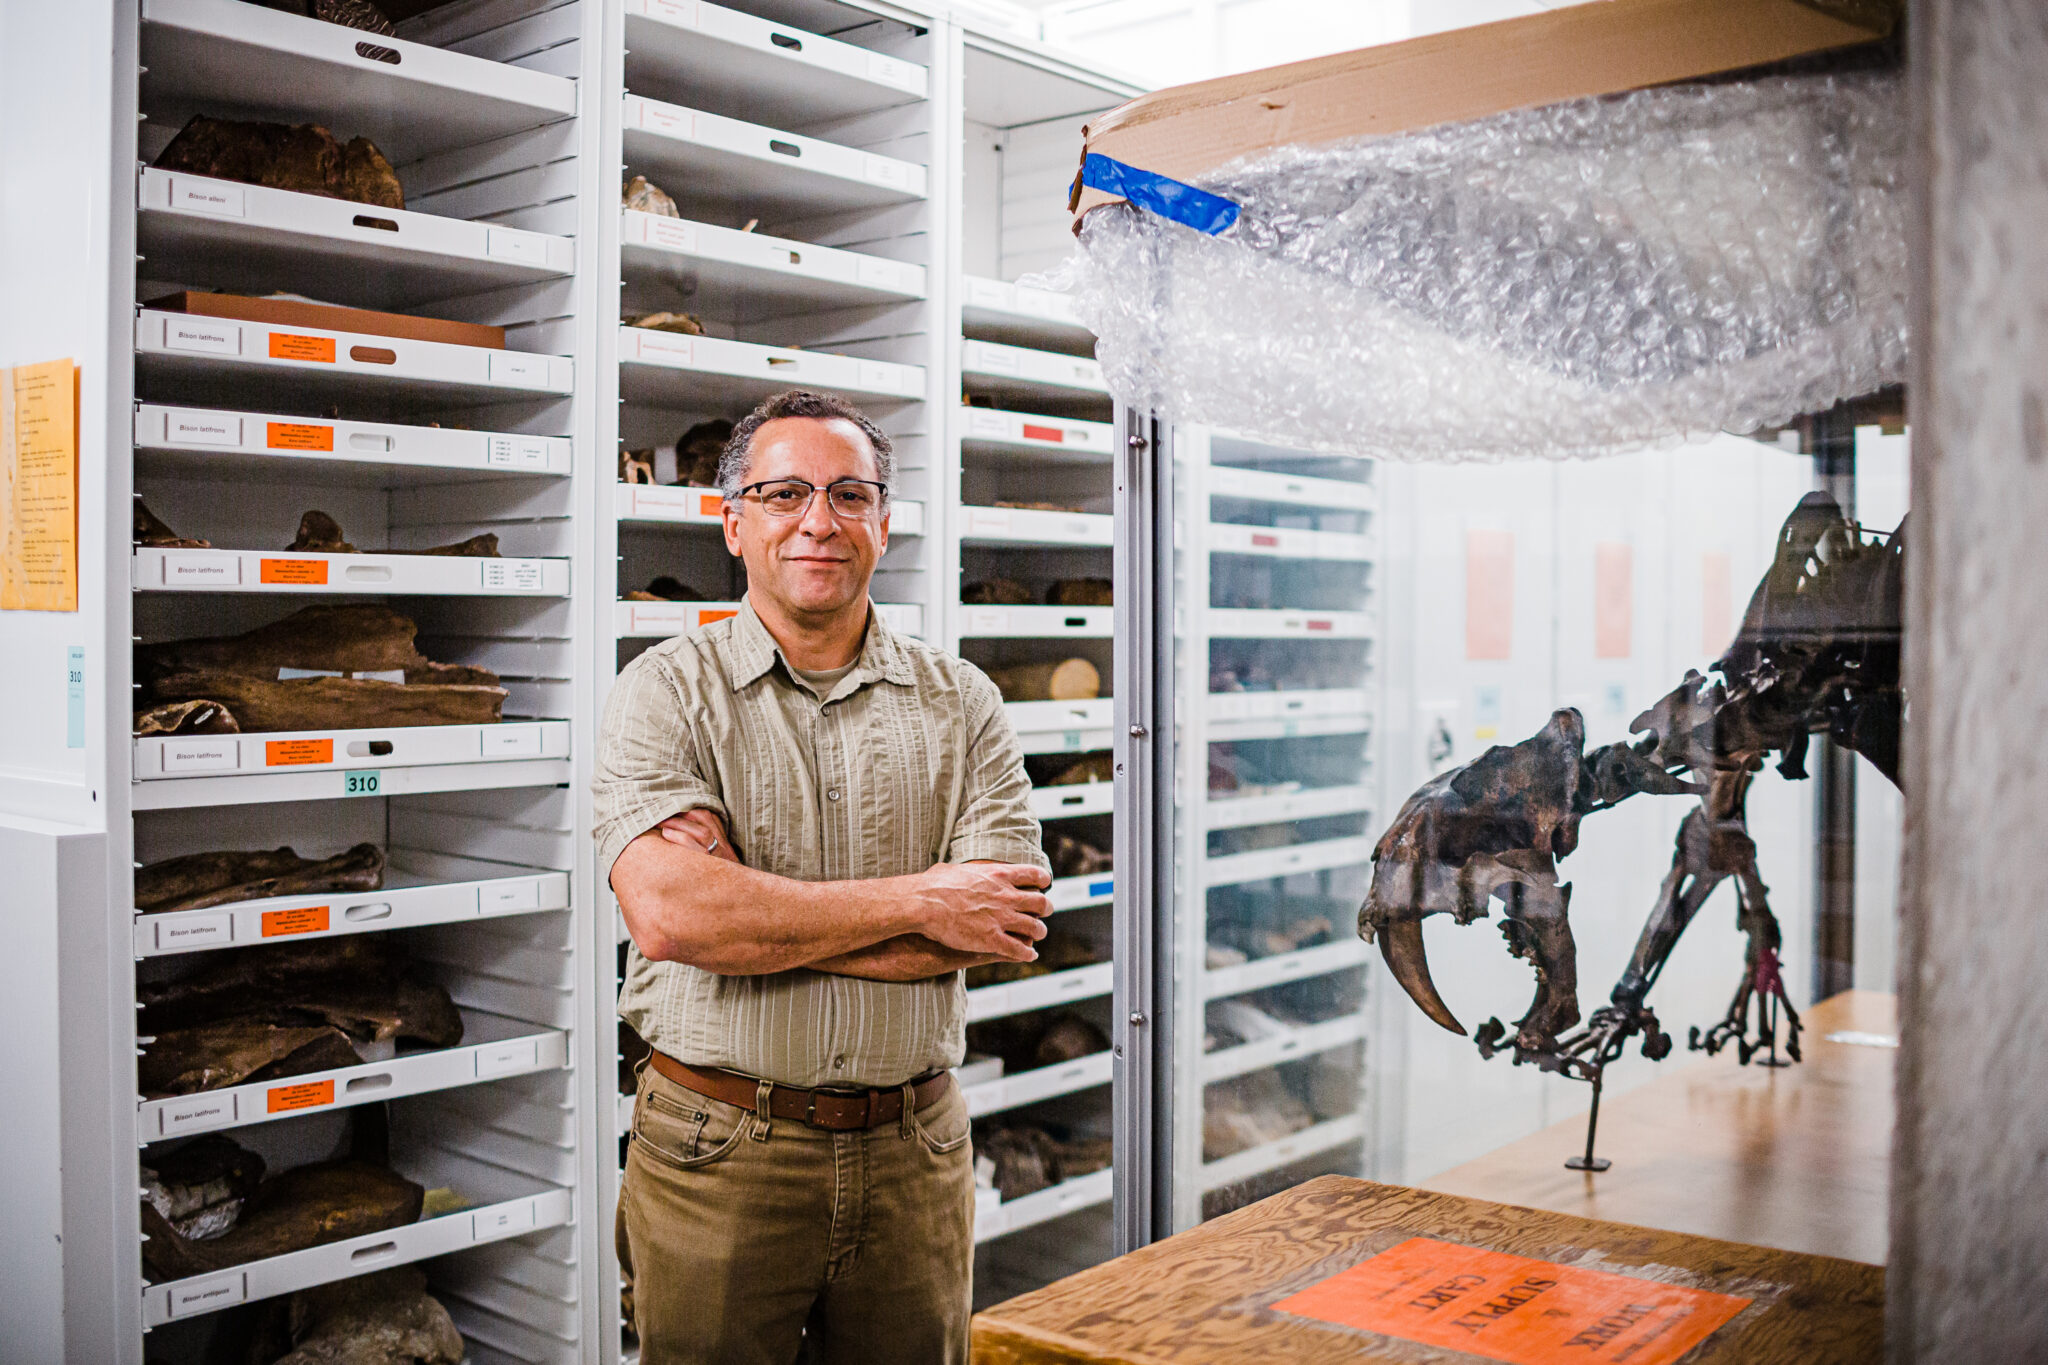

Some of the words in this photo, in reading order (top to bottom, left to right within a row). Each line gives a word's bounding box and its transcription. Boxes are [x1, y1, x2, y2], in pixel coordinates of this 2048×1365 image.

[178, 331, 197, 339] Bison
[199, 334, 224, 342] latifrons
[179, 424, 198, 432] Bison
[177, 566, 197, 574] Bison
[70, 670, 82, 683] 310
[348, 776, 378, 792] 310
[174, 1113, 193, 1122] Bison
[1407, 1274, 1487, 1314] CART
[1450, 1276, 1558, 1335] SUPPLY
[1562, 1303, 1658, 1352] WORK
